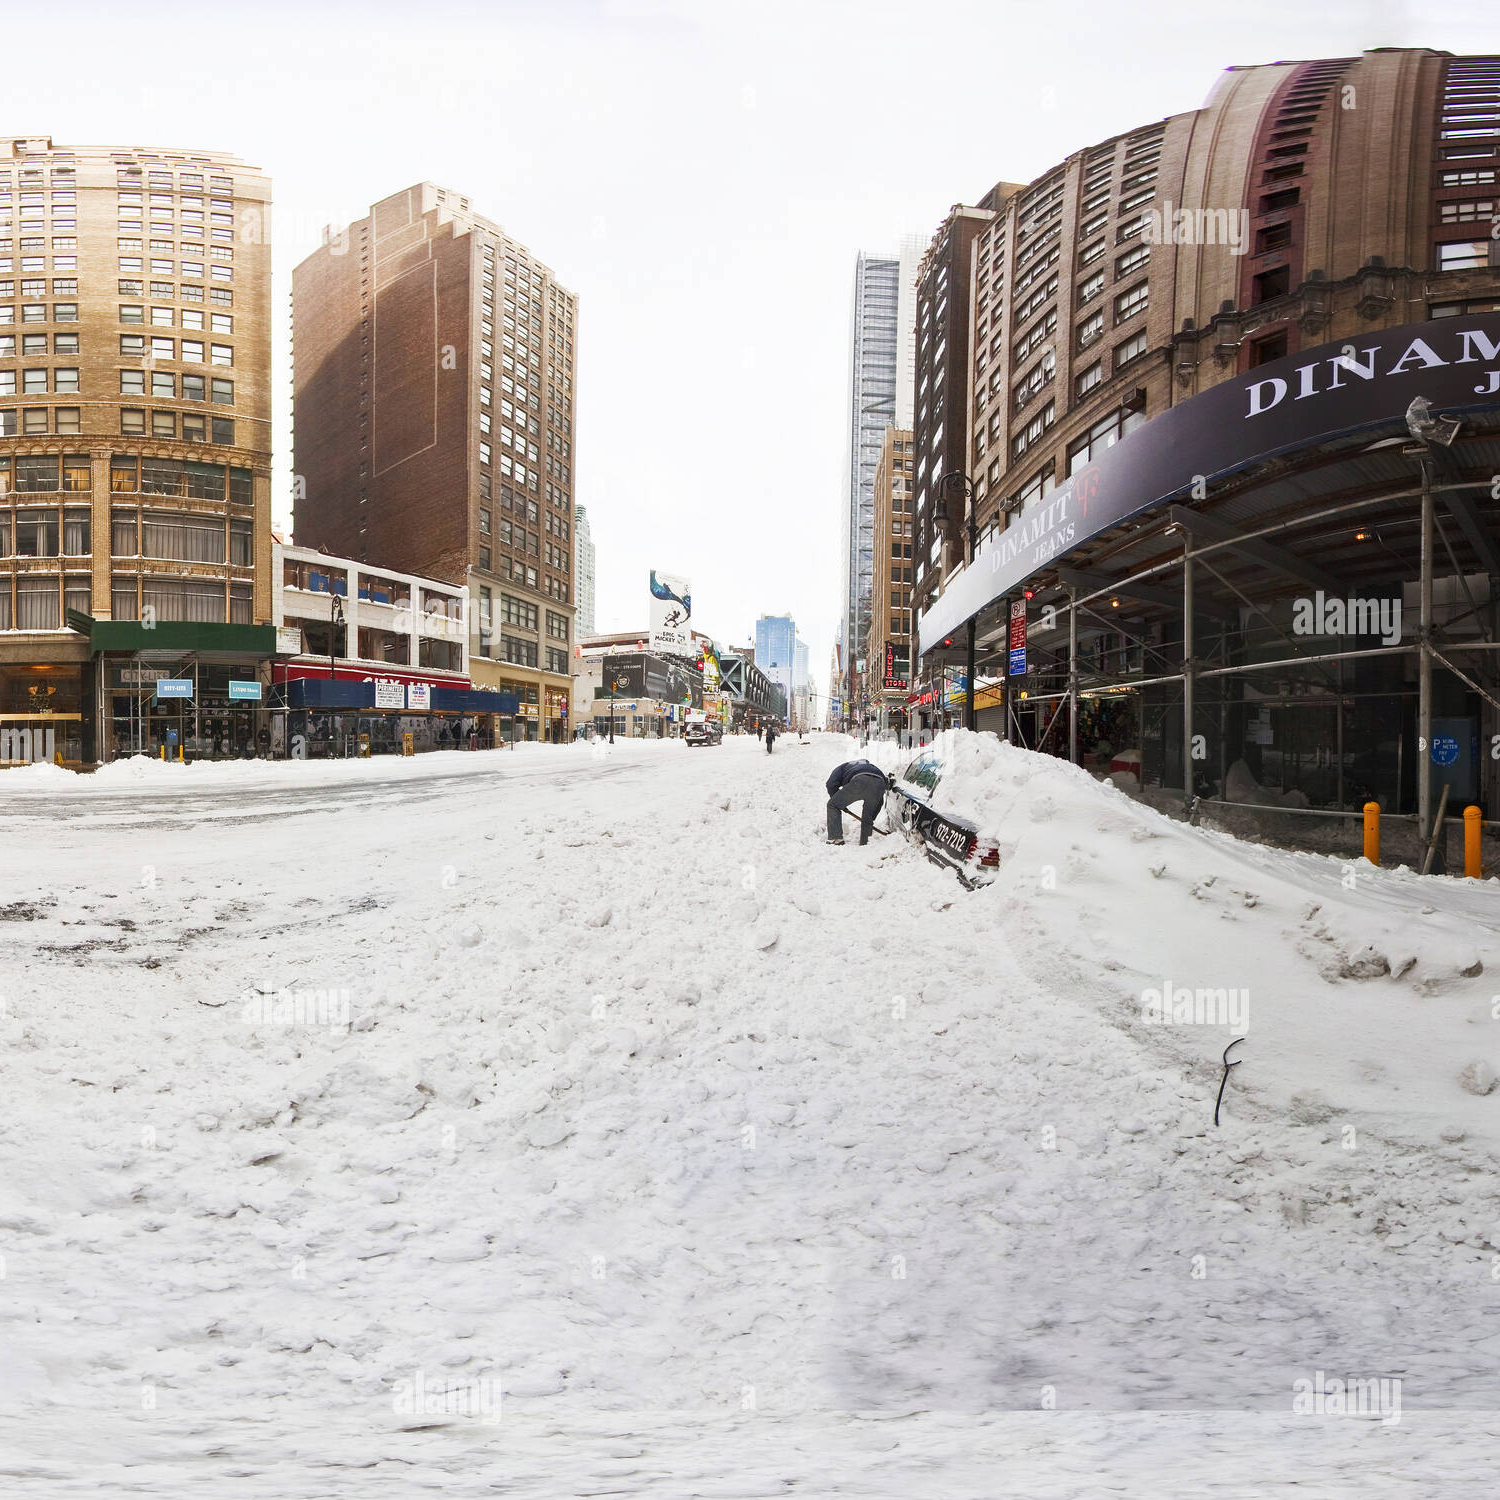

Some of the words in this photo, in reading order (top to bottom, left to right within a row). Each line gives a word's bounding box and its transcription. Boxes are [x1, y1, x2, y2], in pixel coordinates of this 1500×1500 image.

[991, 490, 1072, 574] DINAMIT
[1033, 521, 1075, 564] JEANS
[654, 635, 676, 643] MICKEY
[885, 679, 907, 687] STORE
[935, 822, 967, 853] 972-7212
